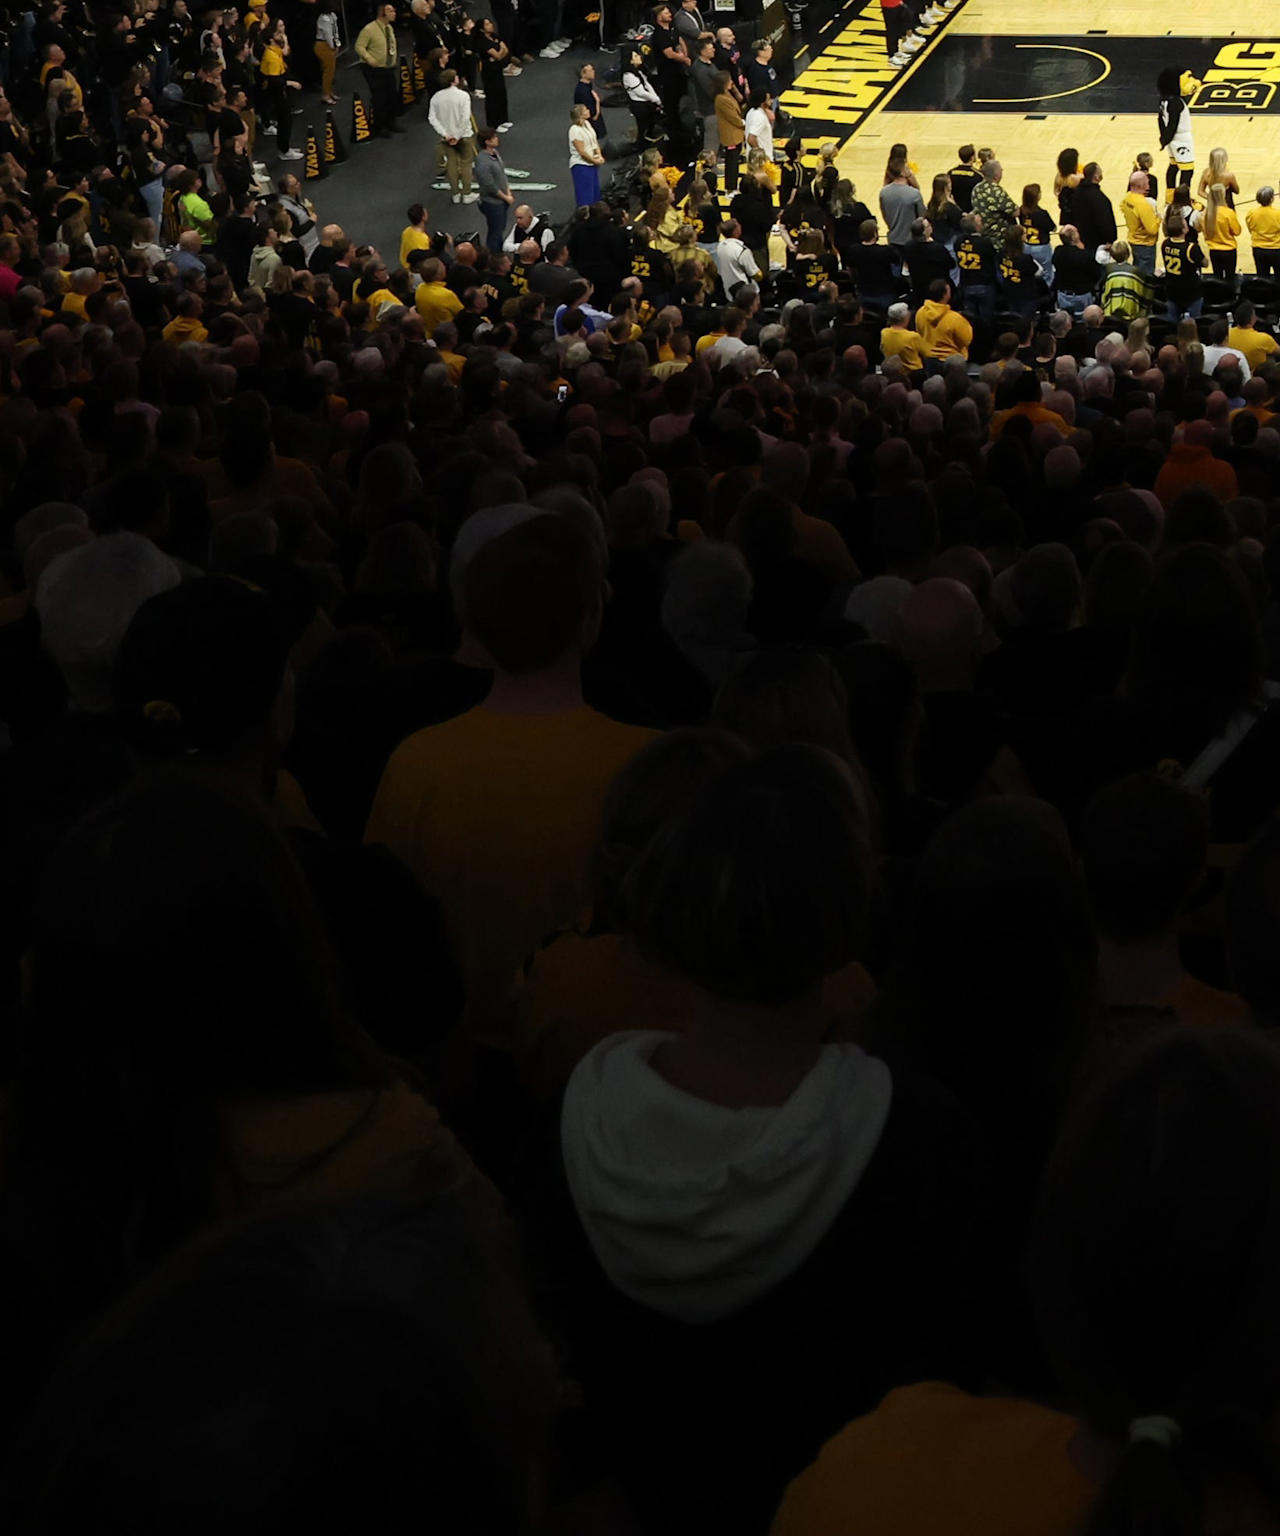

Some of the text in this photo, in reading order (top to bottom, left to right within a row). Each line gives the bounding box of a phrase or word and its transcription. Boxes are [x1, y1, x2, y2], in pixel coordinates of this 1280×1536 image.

[401, 65, 416, 104] IOWA
[353, 99, 372, 142] IOWA
[305, 136, 320, 179] IOWA
[323, 122, 336, 163] IOWA
[631, 261, 651, 277] 22
[957, 250, 982, 270] 22
[1164, 255, 1182, 276] 22
